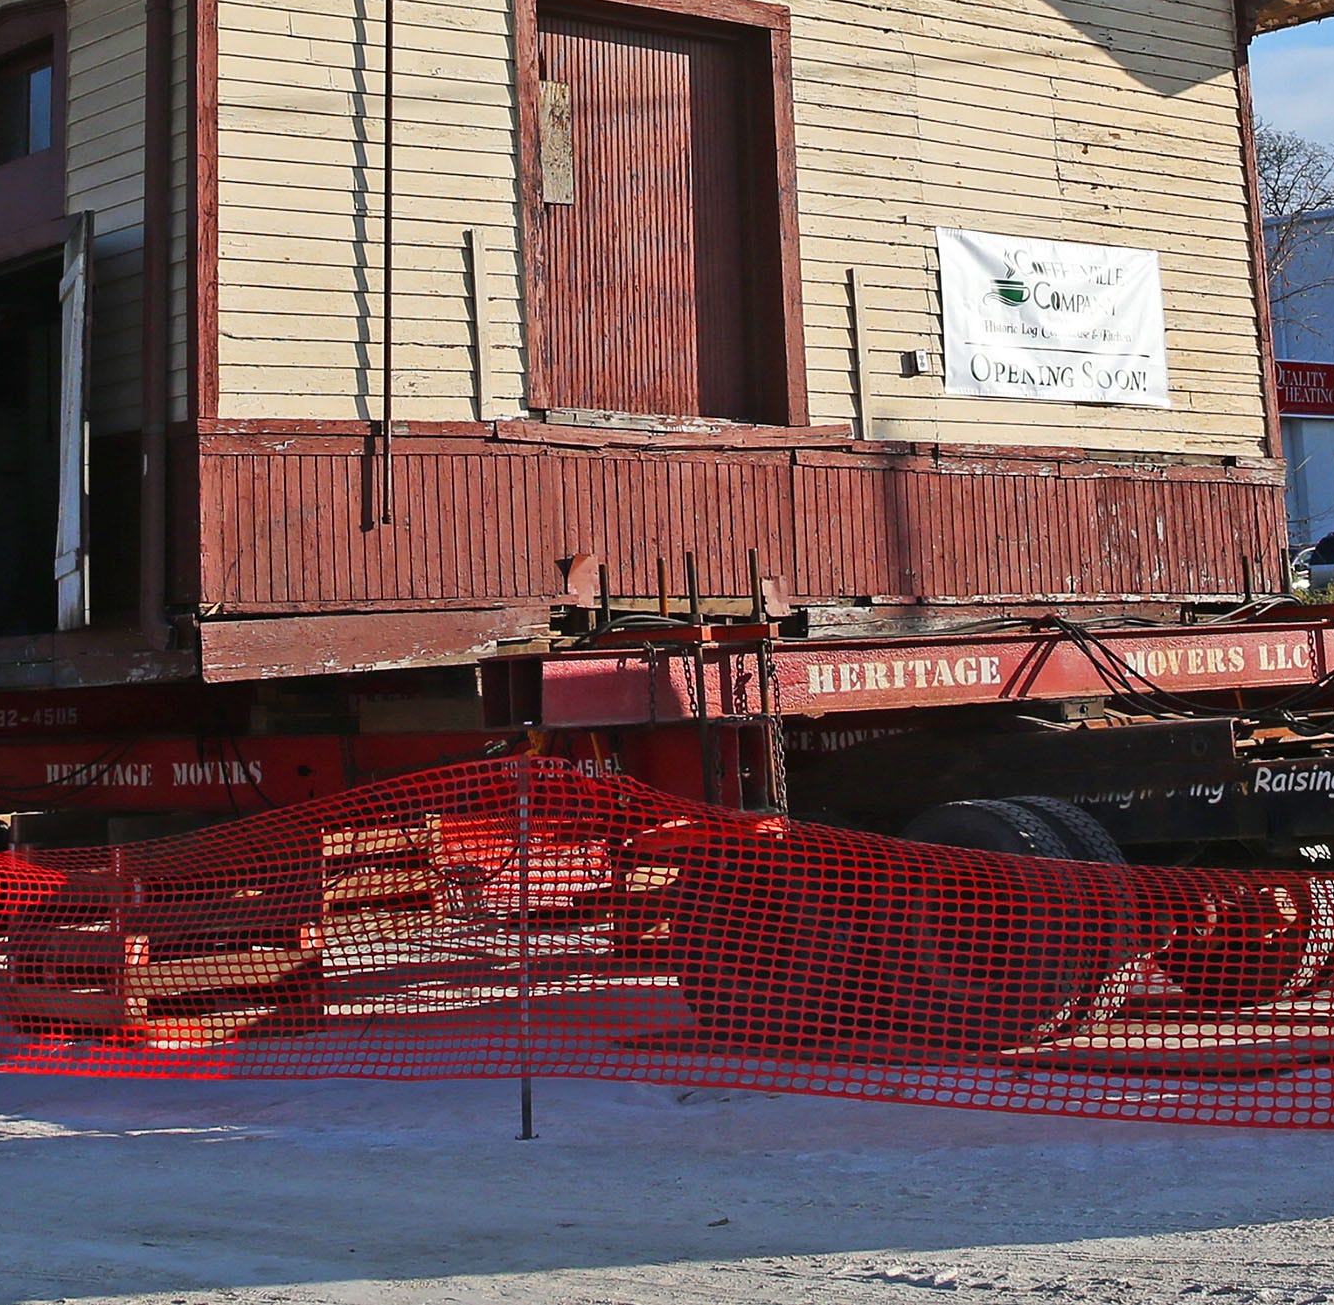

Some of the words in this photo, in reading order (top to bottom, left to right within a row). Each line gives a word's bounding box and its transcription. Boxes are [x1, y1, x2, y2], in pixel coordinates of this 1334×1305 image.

[1021, 323, 1038, 337] Log
[970, 352, 1074, 389] OPENING
[1082, 360, 1148, 393] SOON!
[1275, 362, 1327, 390] QUALITY
[807, 656, 1002, 695] HERITAGE
[1123, 645, 1246, 679] MOVERS
[1257, 644, 1310, 672] LLC
[45, 762, 154, 787] HERITAGE
[172, 760, 263, 787] MOVERS
